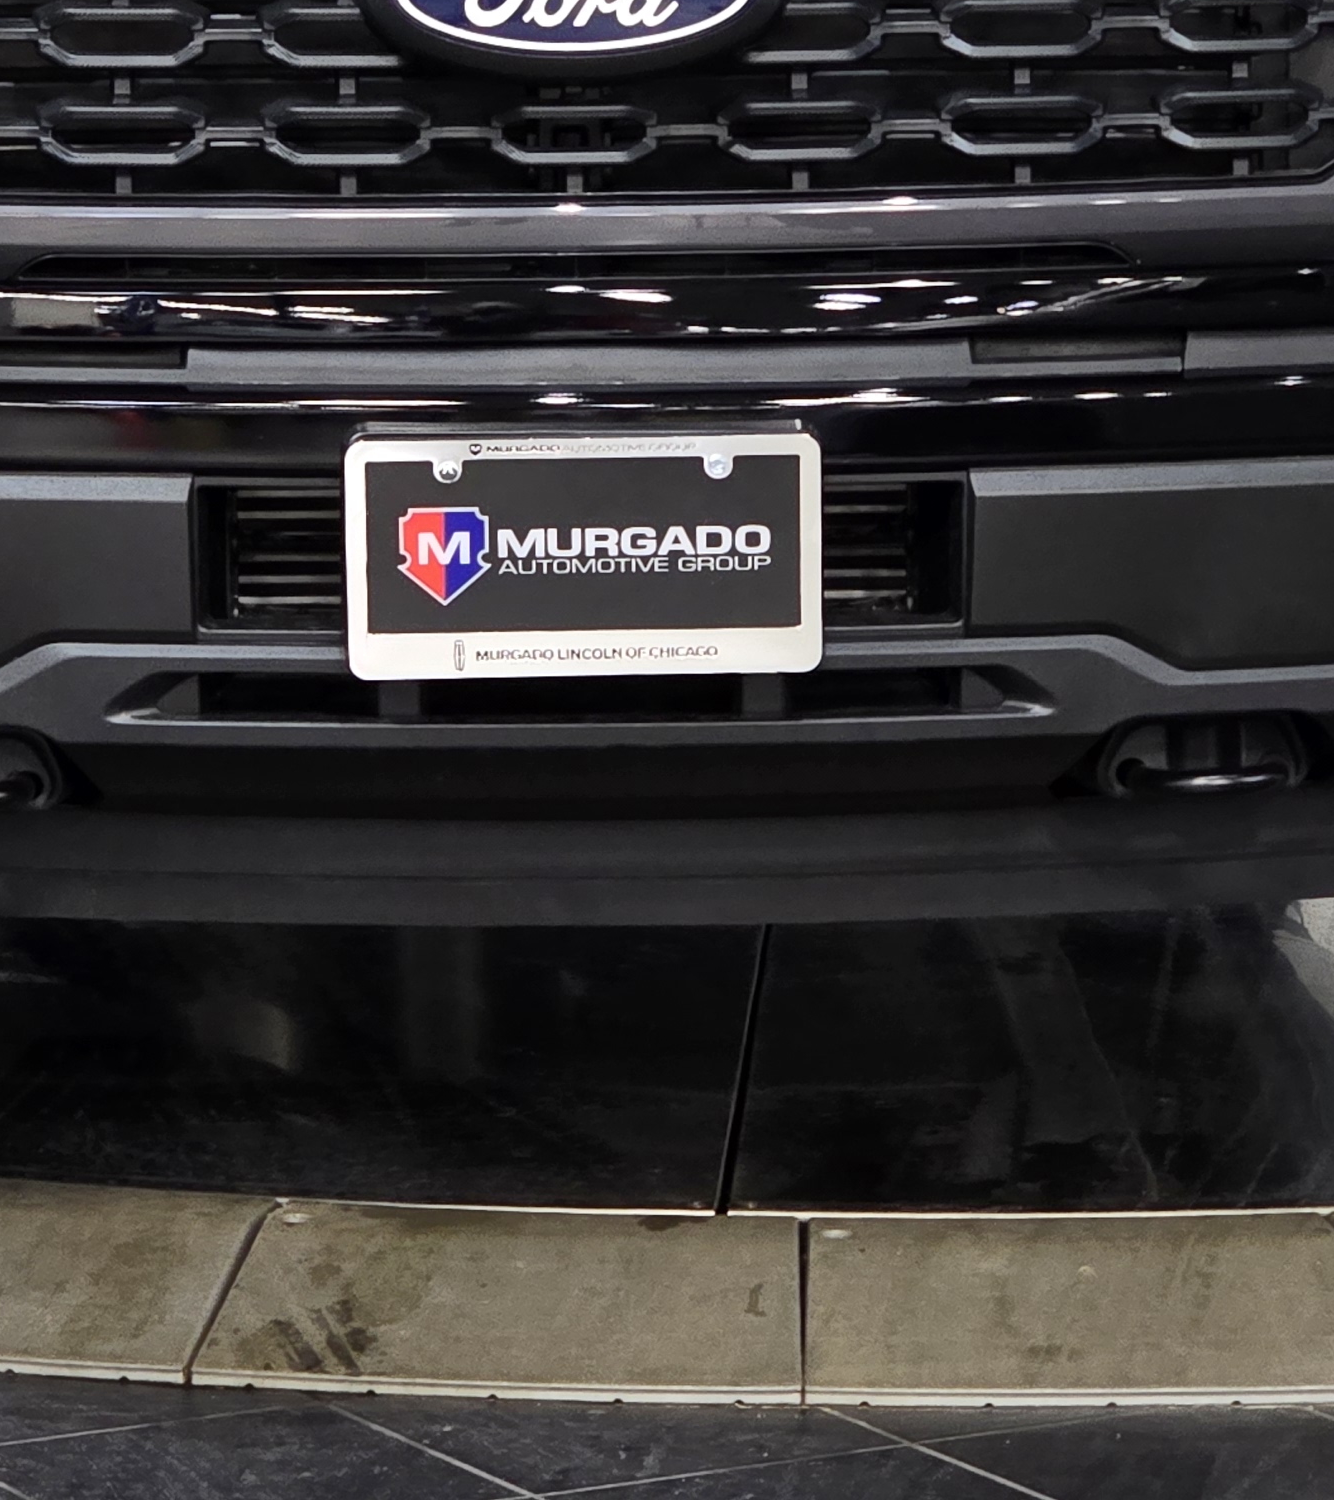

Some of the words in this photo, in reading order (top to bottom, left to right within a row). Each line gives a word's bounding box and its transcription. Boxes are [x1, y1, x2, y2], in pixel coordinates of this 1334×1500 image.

[486, 444, 560, 453] MURGADO
[417, 531, 470, 565] M
[497, 525, 772, 558] MURGADO
[498, 556, 669, 575] AUTOMOTIVE
[677, 555, 772, 572] GROUP
[475, 649, 555, 662] MURGADO
[557, 648, 623, 661] LINCOLN
[625, 647, 646, 658] OF
[648, 645, 719, 659] CHICAGO
